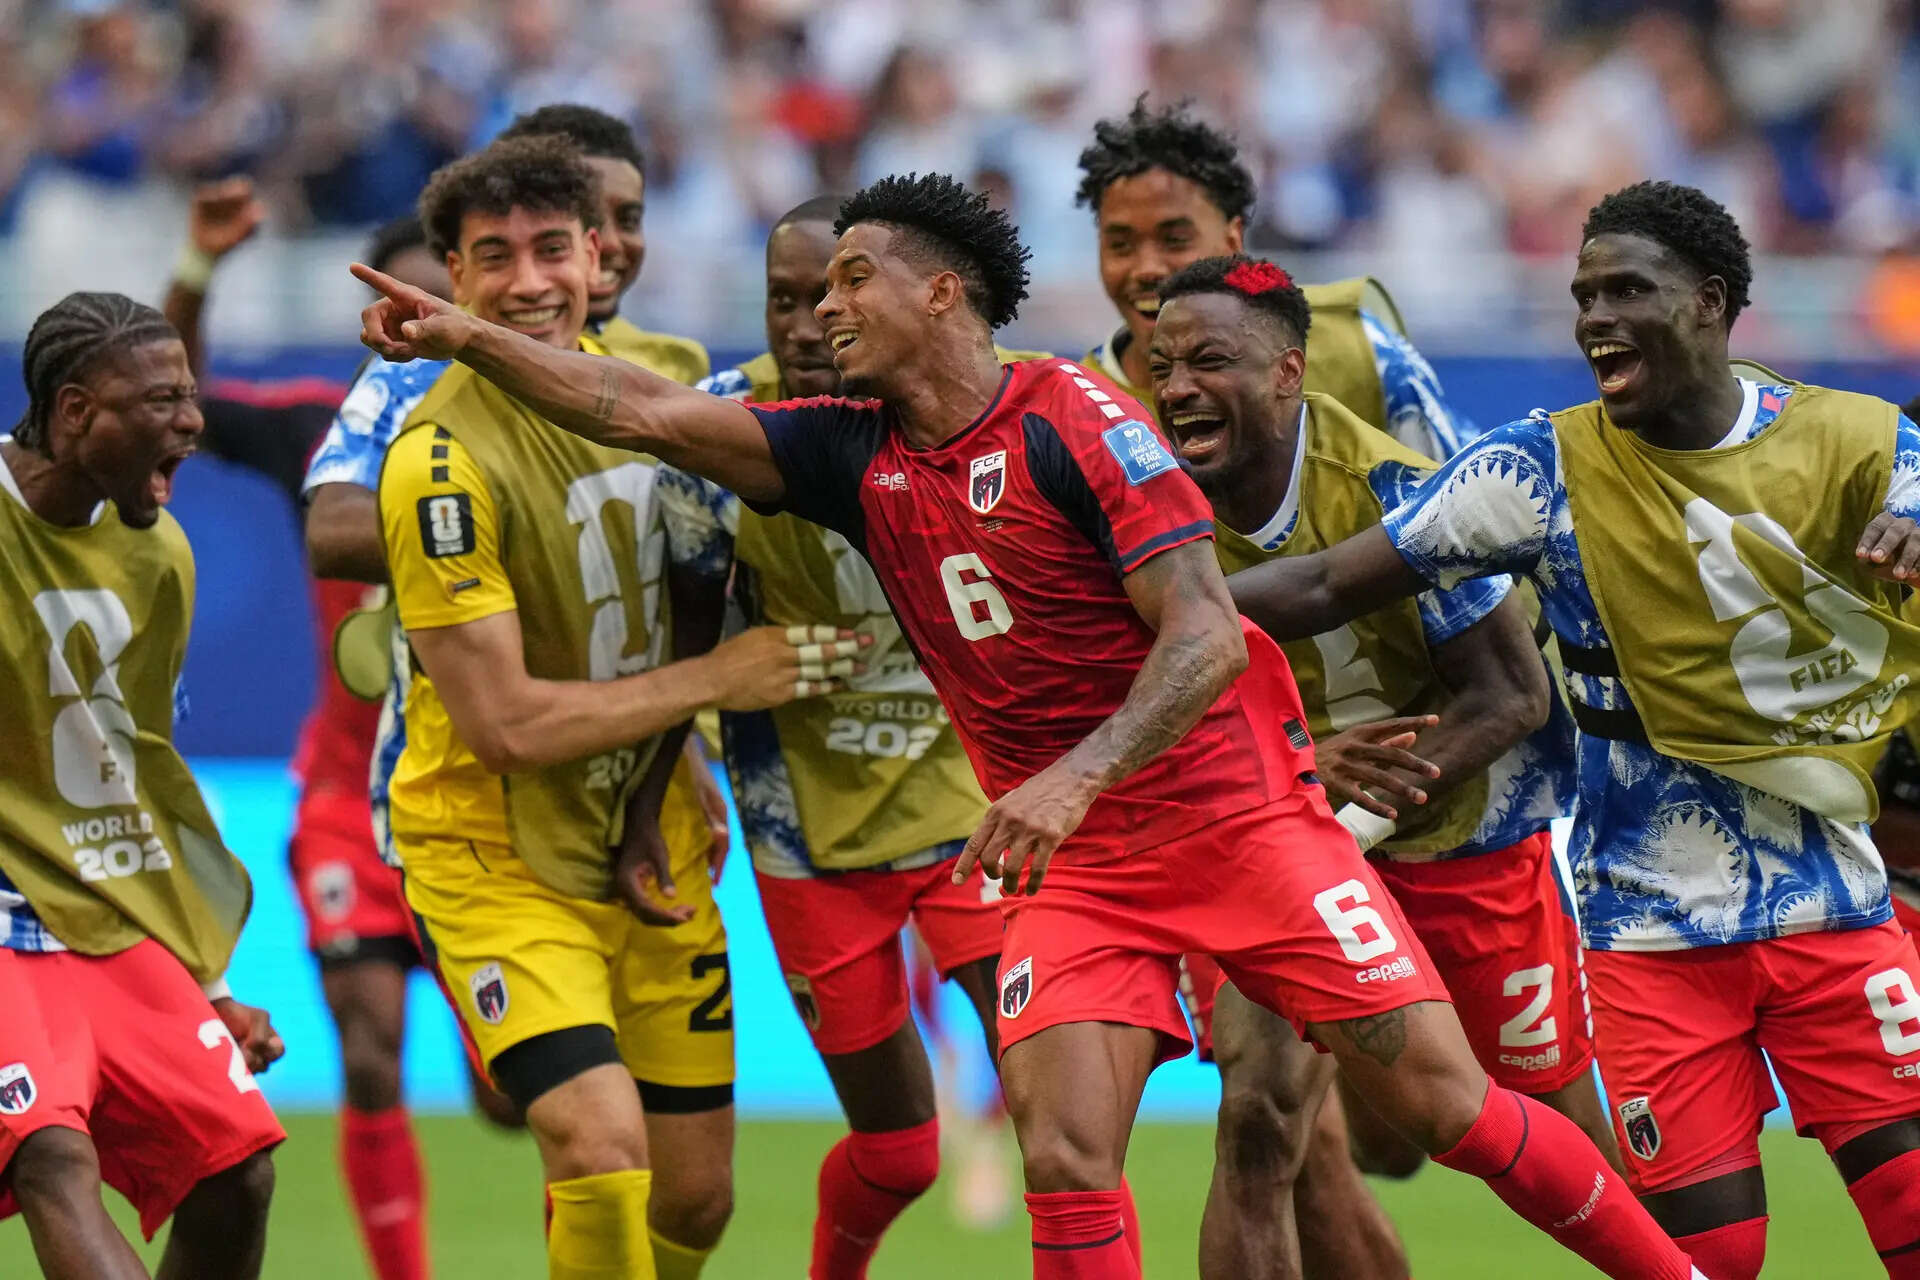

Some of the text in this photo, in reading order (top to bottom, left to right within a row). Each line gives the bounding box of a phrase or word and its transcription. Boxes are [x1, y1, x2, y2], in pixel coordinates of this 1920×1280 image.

[973, 453, 1004, 471] FCF
[940, 552, 1014, 642] 6
[1788, 647, 1859, 694] FIFA
[1313, 878, 1397, 963] 6
[689, 952, 732, 1032] 2
[1004, 959, 1030, 983] FCF
[1356, 956, 1415, 983] capelli
[1499, 963, 1557, 1047] 2
[1863, 967, 1920, 1056] 8
[197, 1018, 261, 1094] 2
[1500, 1044, 1560, 1070] capelli
[1621, 1099, 1645, 1117] FCF
